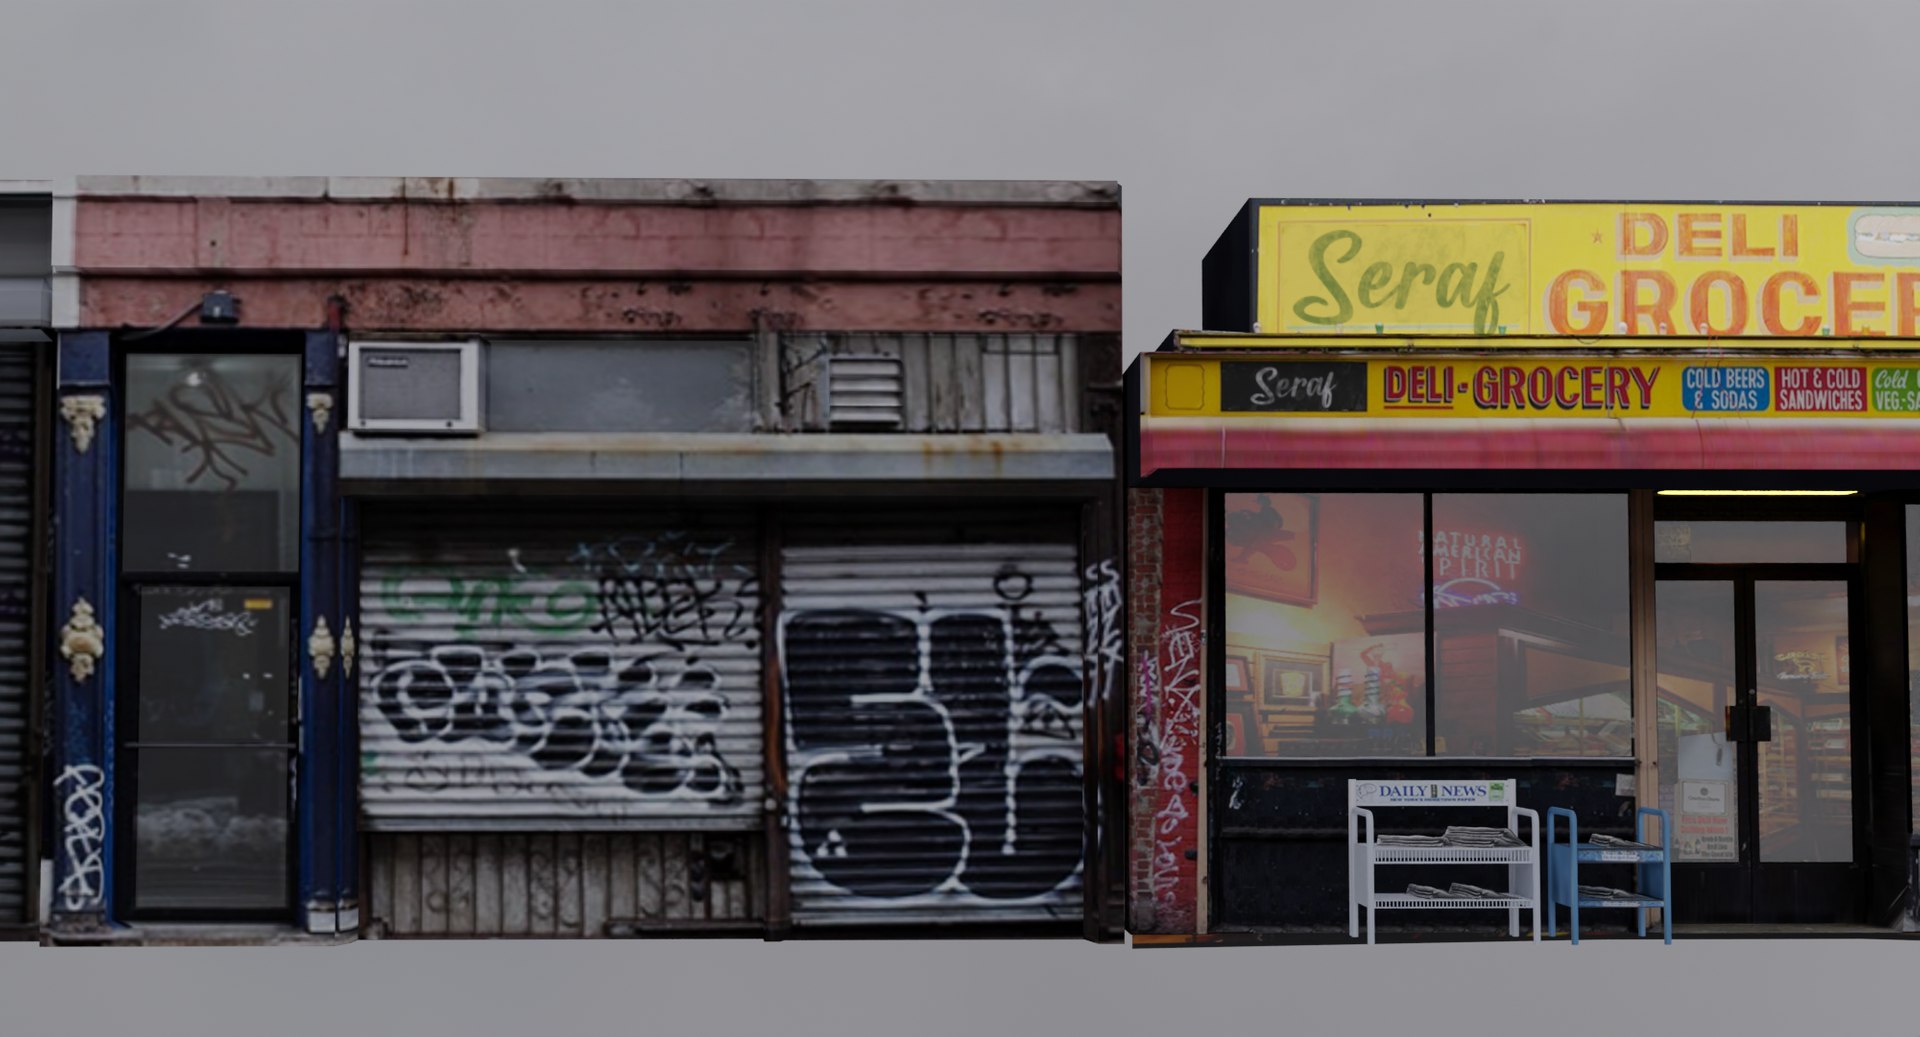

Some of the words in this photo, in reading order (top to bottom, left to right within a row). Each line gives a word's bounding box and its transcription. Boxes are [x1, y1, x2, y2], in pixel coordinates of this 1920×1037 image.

[1616, 212, 1798, 261] DELI
[1293, 229, 1511, 335] Seraf
[1250, 366, 1337, 408] Seraf
[1686, 368, 1721, 389] COLD
[1726, 368, 1765, 389] BEERS
[1781, 368, 1809, 389] HOT
[1813, 368, 1822, 389] &
[1827, 368, 1861, 389] COLD
[1875, 368, 1909, 389] Cold
[1694, 390, 1703, 409] &
[1711, 390, 1758, 410] SODAS
[1780, 390, 1863, 410] SANDWICHES
[1421, 556, 1521, 579] PIRIT
[1379, 785, 1428, 797] DAILY
[1441, 785, 1487, 797] NEWS
